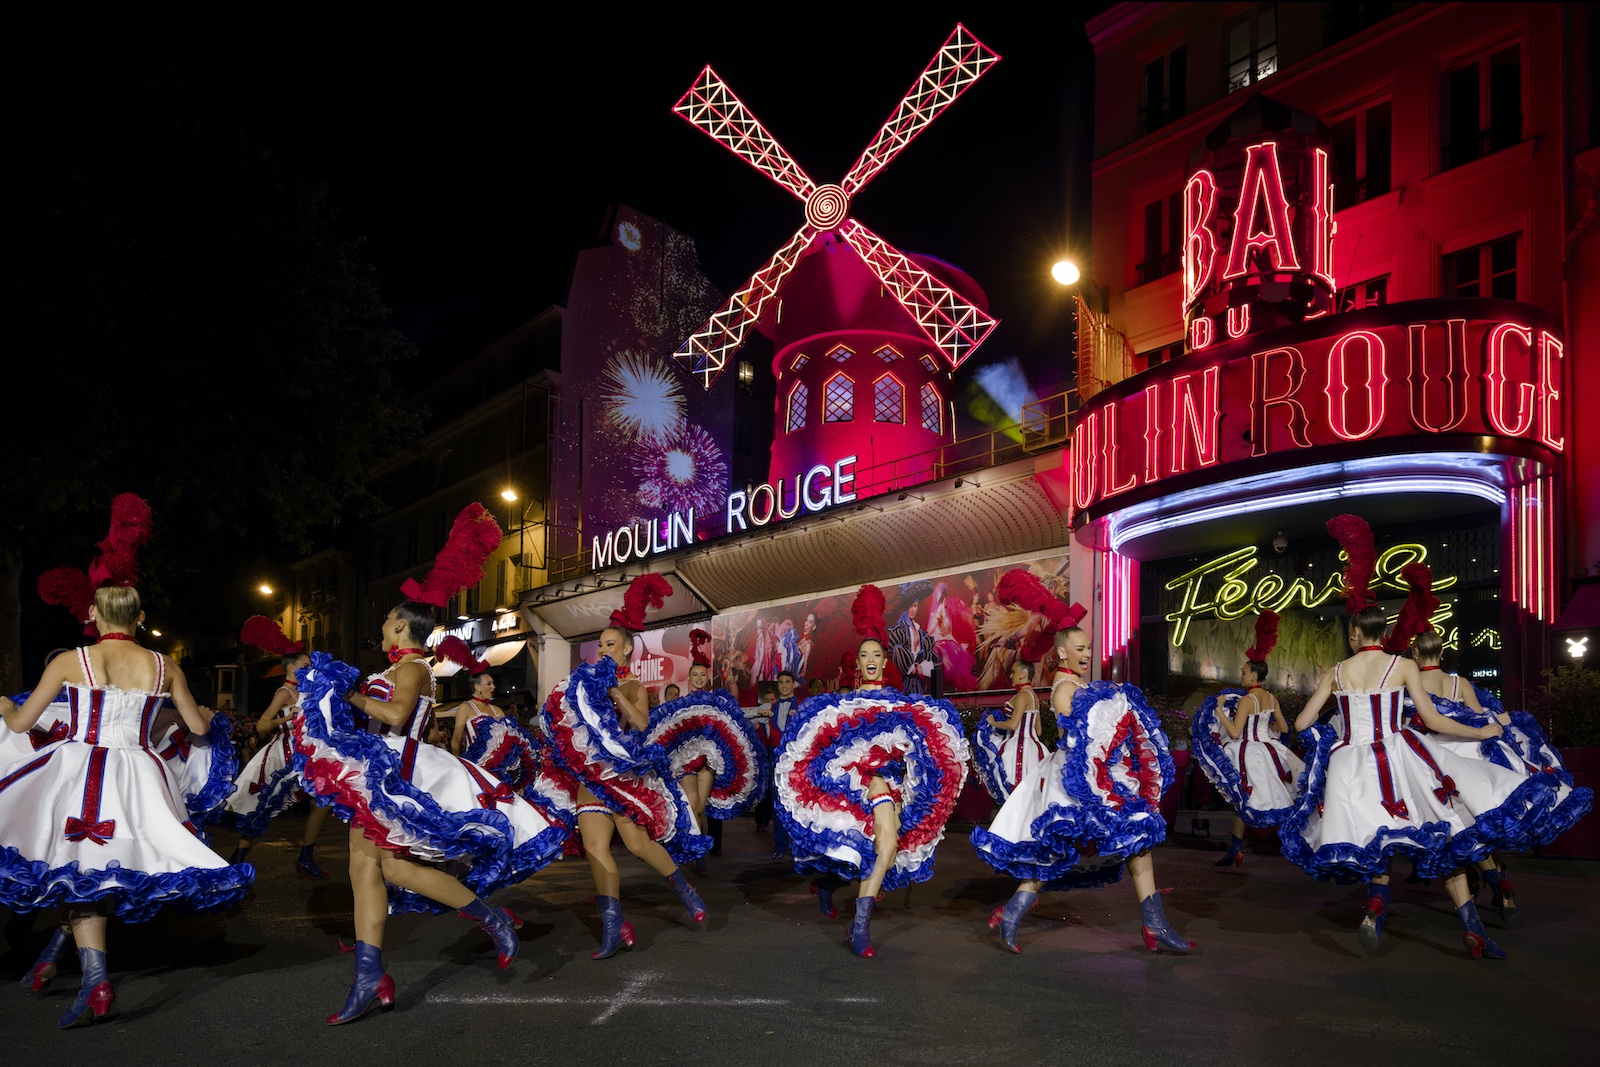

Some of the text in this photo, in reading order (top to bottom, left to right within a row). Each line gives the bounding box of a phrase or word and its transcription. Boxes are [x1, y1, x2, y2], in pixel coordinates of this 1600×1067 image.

[1190, 304, 1250, 350] DU
[1069, 318, 1565, 513] ULIN ROUGE
[591, 455, 857, 570] MOULIN ROUGE
